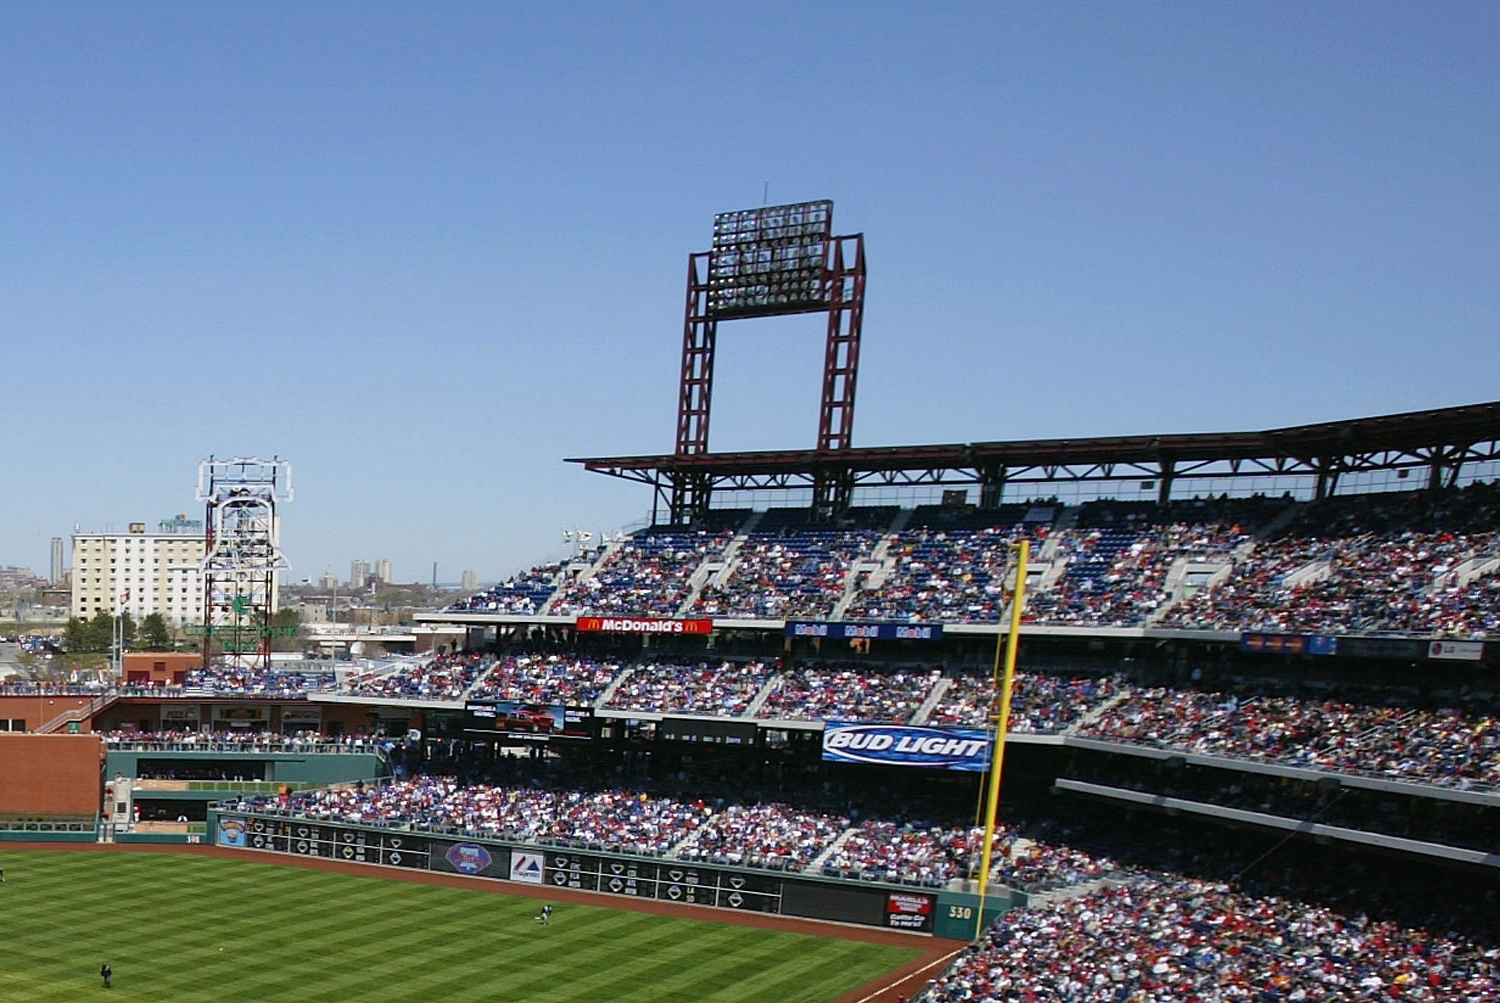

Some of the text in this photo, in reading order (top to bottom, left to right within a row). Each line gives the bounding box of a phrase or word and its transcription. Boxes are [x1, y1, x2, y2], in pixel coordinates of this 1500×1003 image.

[601, 619, 683, 633] McDonald's
[844, 625, 879, 637] Mobil
[896, 626, 931, 639] Mobil
[828, 732, 989, 757] BUD LIGHT
[948, 906, 972, 919] 330
